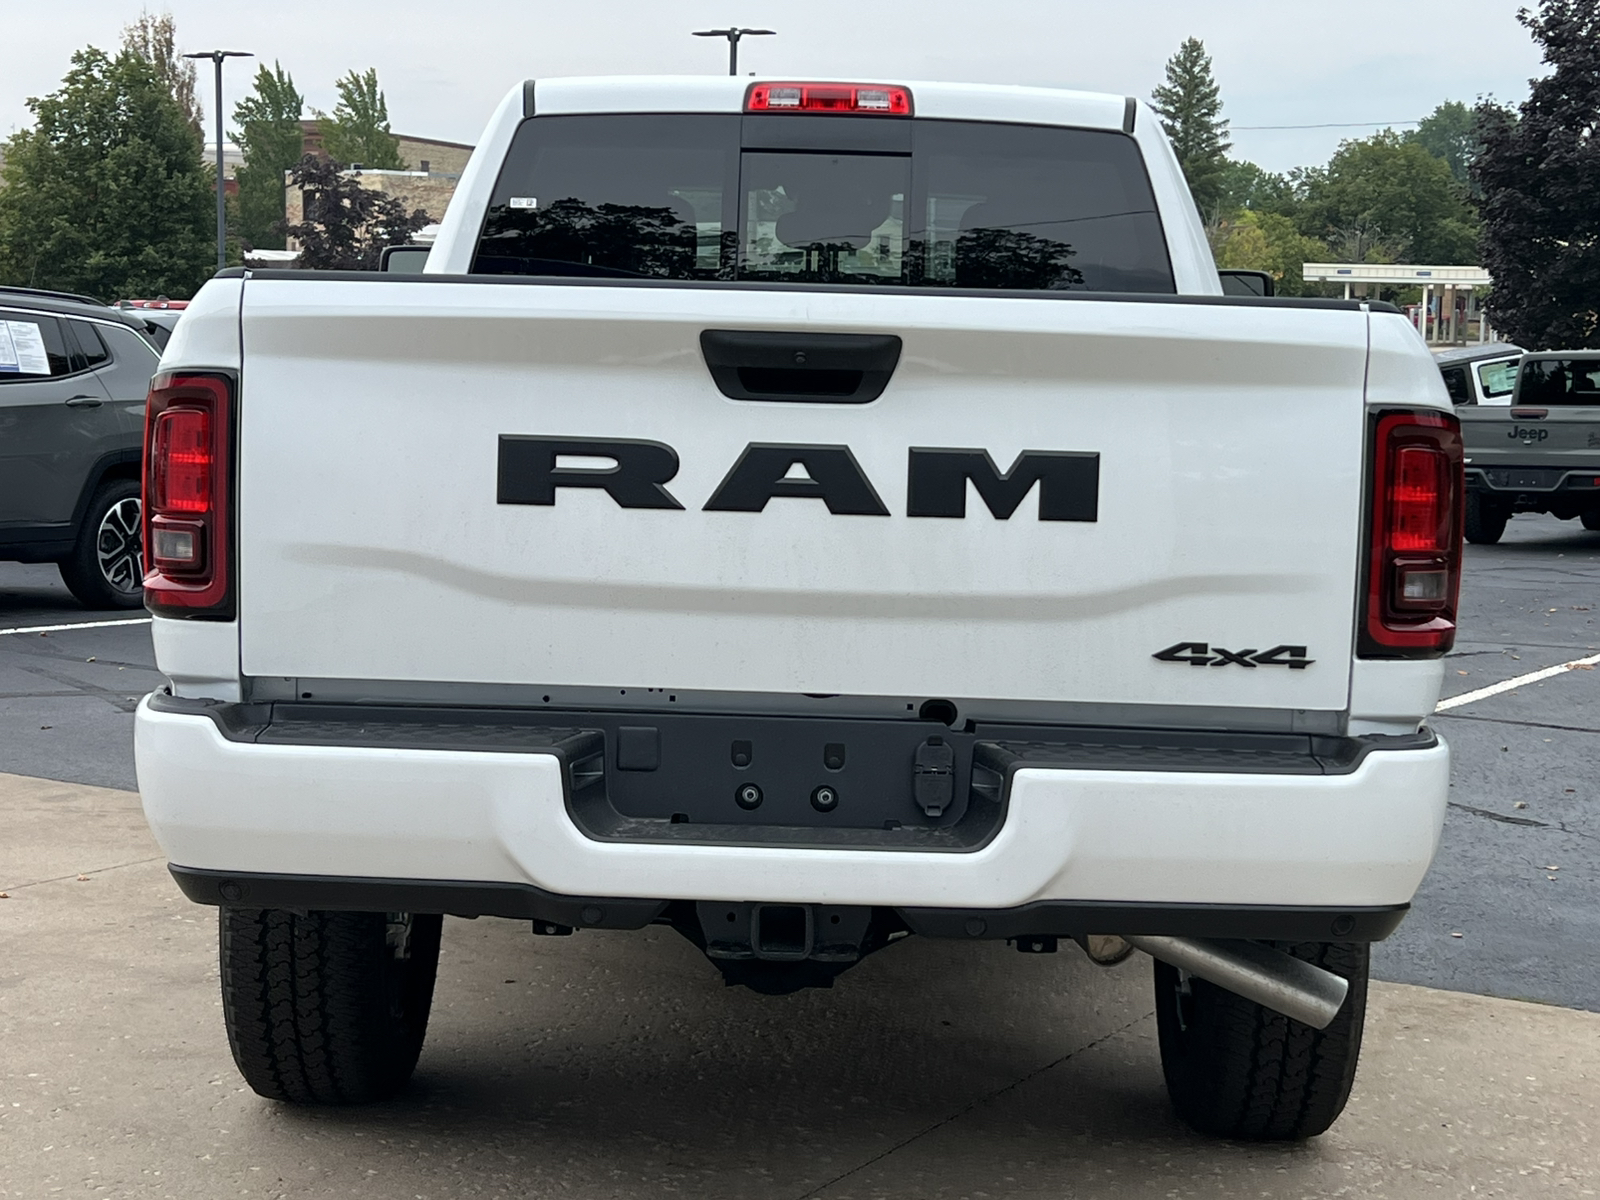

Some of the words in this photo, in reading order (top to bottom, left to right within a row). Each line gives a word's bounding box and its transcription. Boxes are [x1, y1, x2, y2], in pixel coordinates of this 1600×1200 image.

[1507, 425, 1548, 441] Jeep
[497, 433, 1100, 522] RAM
[1151, 642, 1316, 669] 4x4
